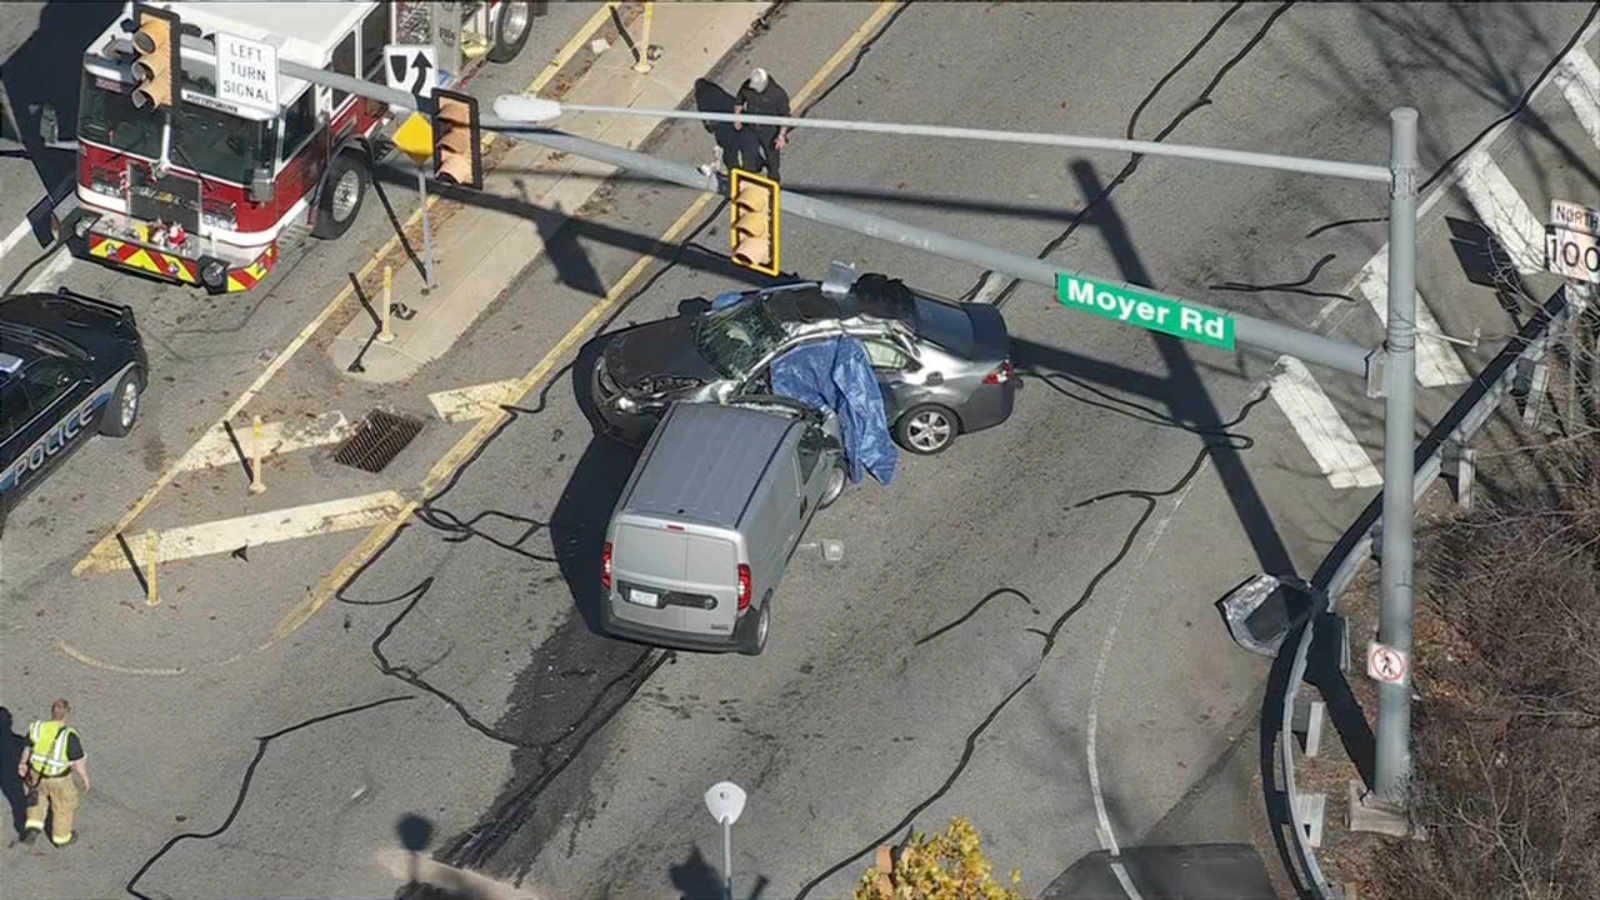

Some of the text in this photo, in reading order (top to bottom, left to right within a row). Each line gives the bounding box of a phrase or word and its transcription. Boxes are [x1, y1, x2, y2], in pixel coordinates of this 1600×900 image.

[230, 42, 262, 61] LEFT
[230, 61, 266, 82] TURN
[223, 79, 274, 104] SIGNAL
[1551, 238, 1600, 272] 100
[1068, 278, 1224, 340] Moyer Rd
[13, 398, 93, 486] POLICE
